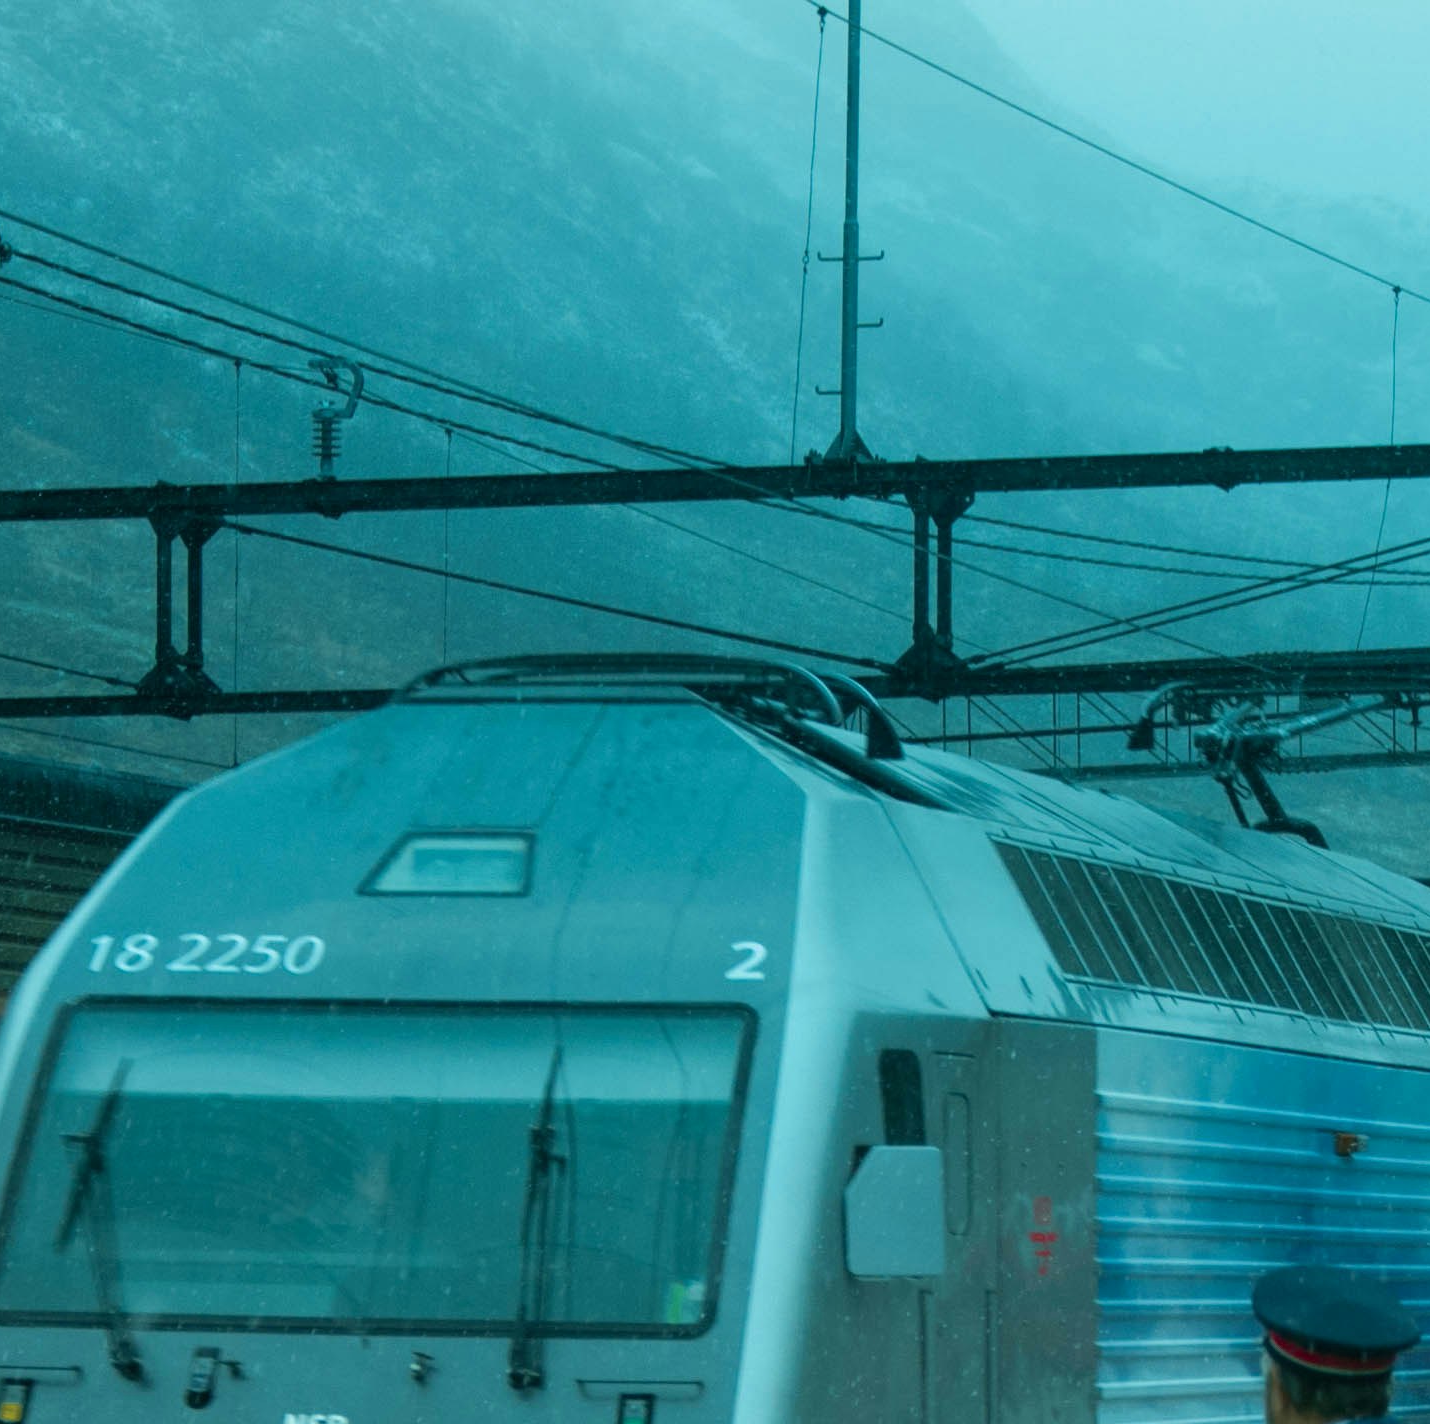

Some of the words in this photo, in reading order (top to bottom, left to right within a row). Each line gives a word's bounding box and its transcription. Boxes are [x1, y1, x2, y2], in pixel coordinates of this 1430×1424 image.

[88, 933, 159, 973] 18
[165, 933, 326, 974] 2250
[724, 941, 768, 980] 2
